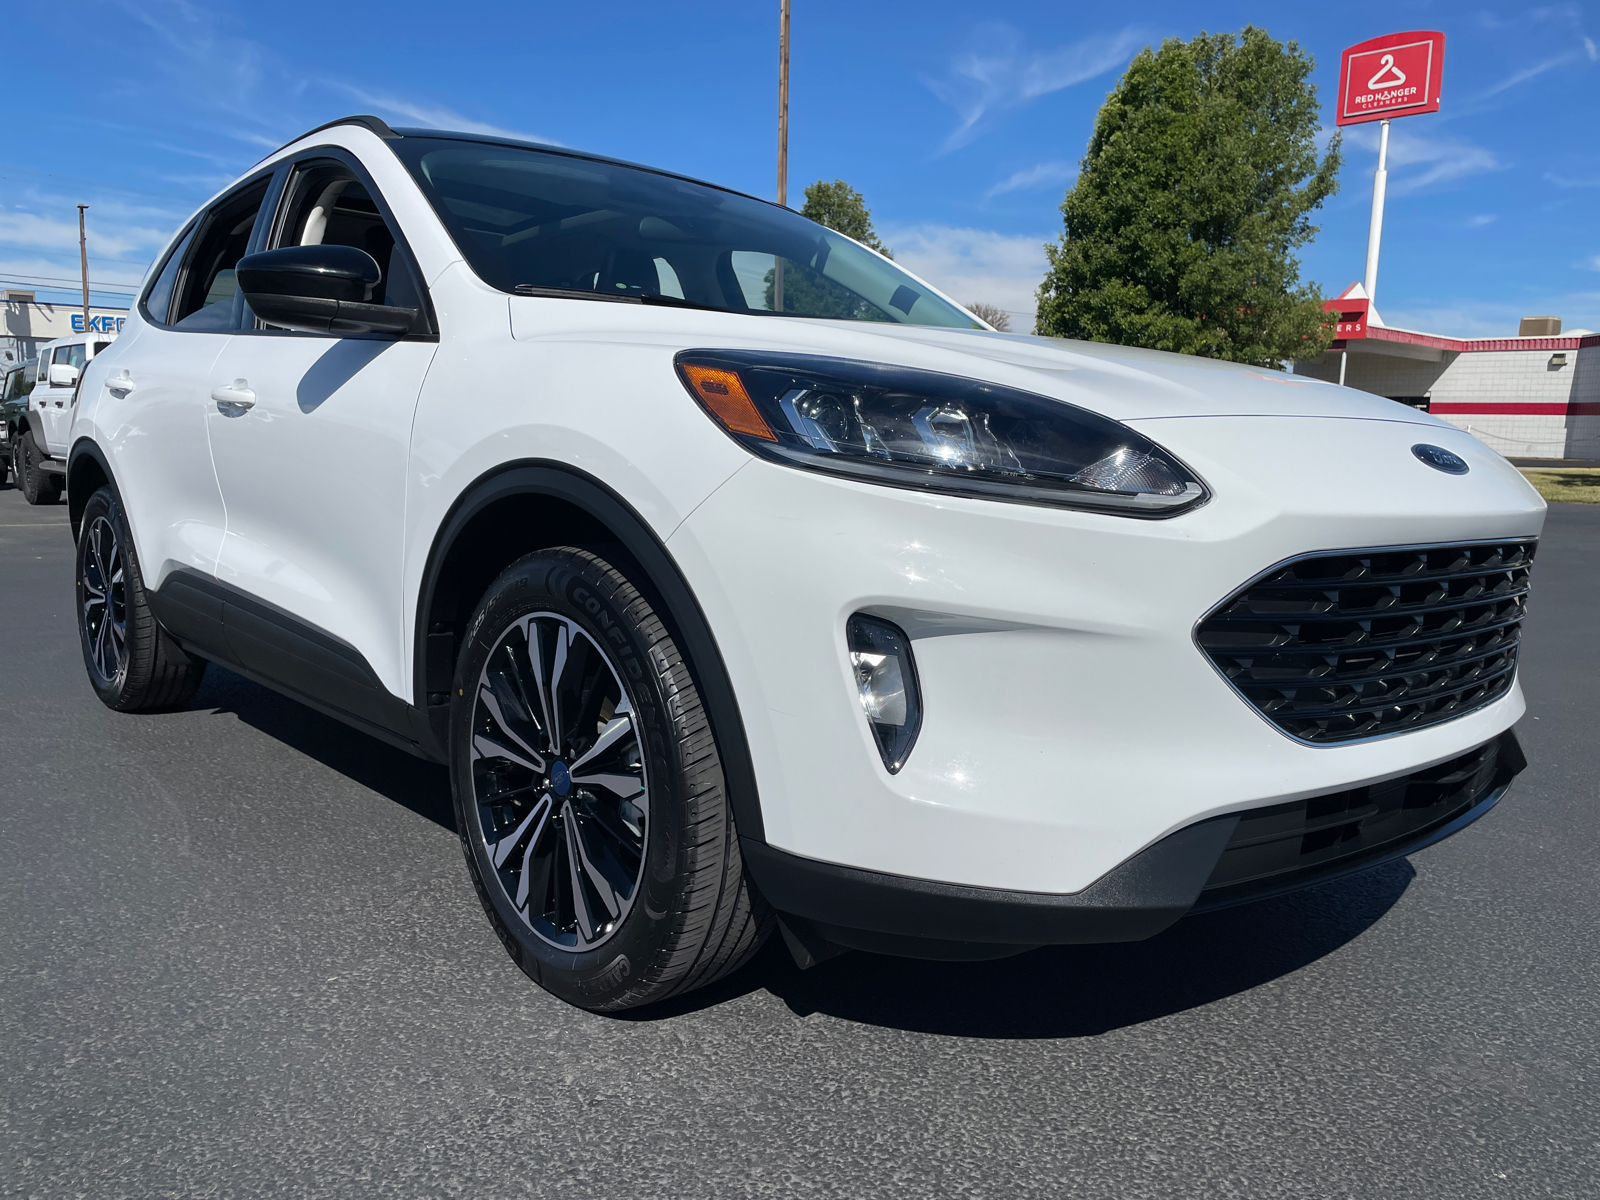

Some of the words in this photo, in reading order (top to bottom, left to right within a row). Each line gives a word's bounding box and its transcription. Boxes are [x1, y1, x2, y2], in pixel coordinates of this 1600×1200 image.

[1355, 94, 1374, 104] RED
[1375, 86, 1417, 101] HANGER
[1362, 96, 1408, 109] CLEANERS
[1334, 323, 1361, 332] ERS
